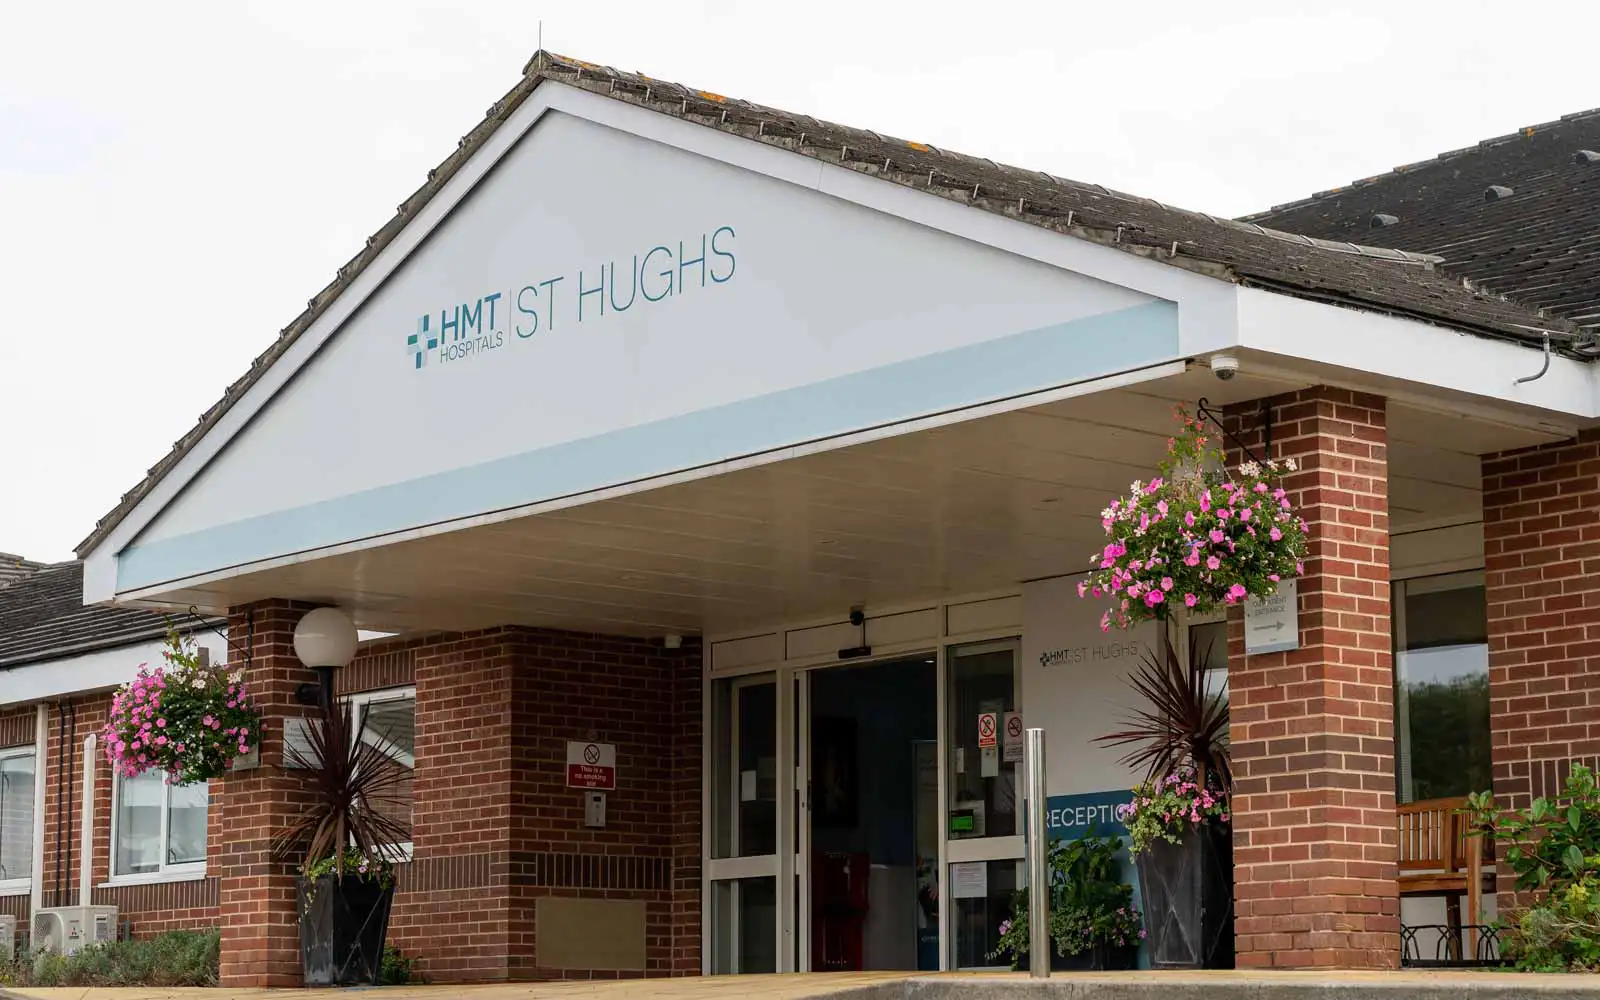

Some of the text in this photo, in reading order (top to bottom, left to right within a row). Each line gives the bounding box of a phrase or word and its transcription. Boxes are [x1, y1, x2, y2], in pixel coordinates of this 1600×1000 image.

[516, 226, 736, 338] ST HUGHS
[441, 292, 502, 345] HMT
[440, 331, 504, 363] HOSPITALS
[1049, 648, 1069, 661] HMT
[1046, 803, 1130, 828] ECEPTIO
